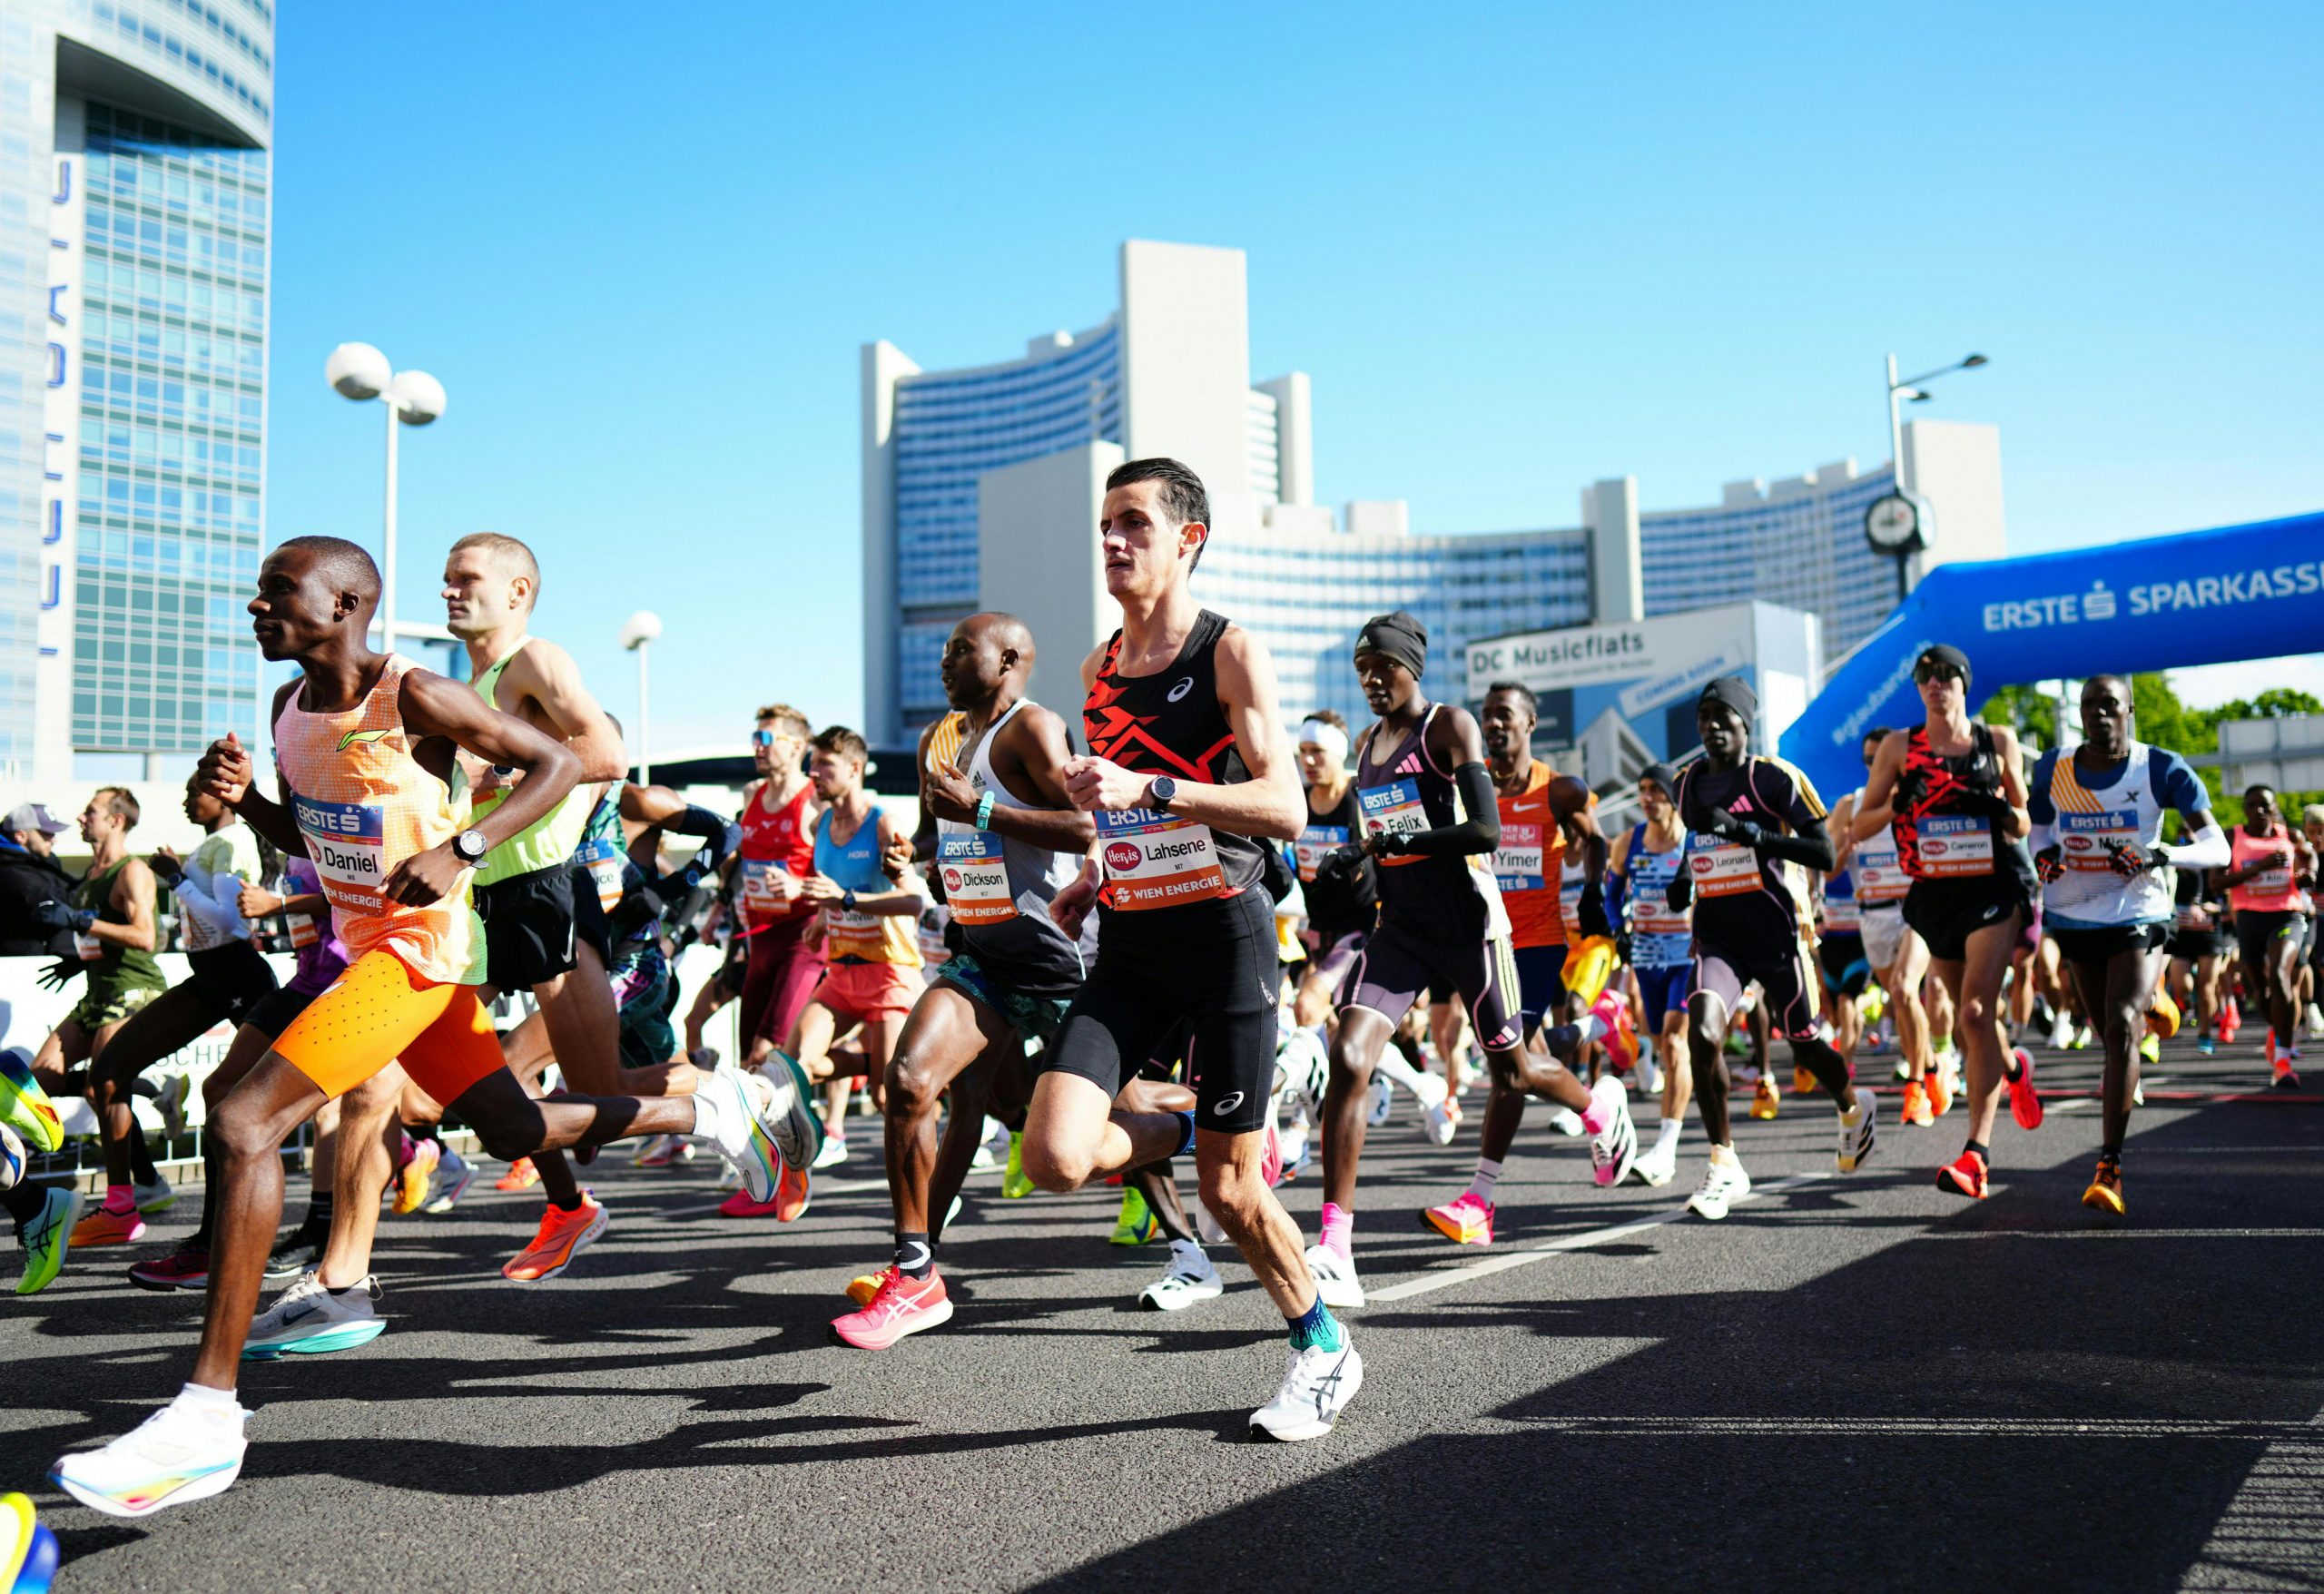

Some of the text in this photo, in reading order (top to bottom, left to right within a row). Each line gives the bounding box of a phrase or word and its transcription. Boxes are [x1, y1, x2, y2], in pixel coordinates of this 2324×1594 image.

[1983, 594, 2079, 633] ERSTE
[2128, 561, 2324, 615] SPARKASS
[1472, 650, 1505, 674] DC
[1513, 632, 1644, 668] Musicflats
[1364, 792, 1392, 810] ERSTE
[296, 802, 339, 831] ERSTE
[1108, 808, 1158, 826] ERSTE
[1387, 814, 1423, 833] Felix
[2071, 817, 2109, 829] ERSTE
[1928, 820, 1964, 832] ERSTE
[945, 841, 973, 856] ERSTE
[1108, 840, 1206, 864] Hervis Lahsene
[1952, 841, 1988, 851] Cameron
[323, 846, 379, 873] Daniel
[1497, 851, 1540, 867] Yimer
[1716, 853, 1752, 868] Leonard
[963, 872, 1003, 887] Dickson
[1134, 875, 1222, 900] WIEN ENERGIE
[339, 891, 383, 909] ENERGIE
[958, 906, 1014, 918] WIEN ENERGIE
